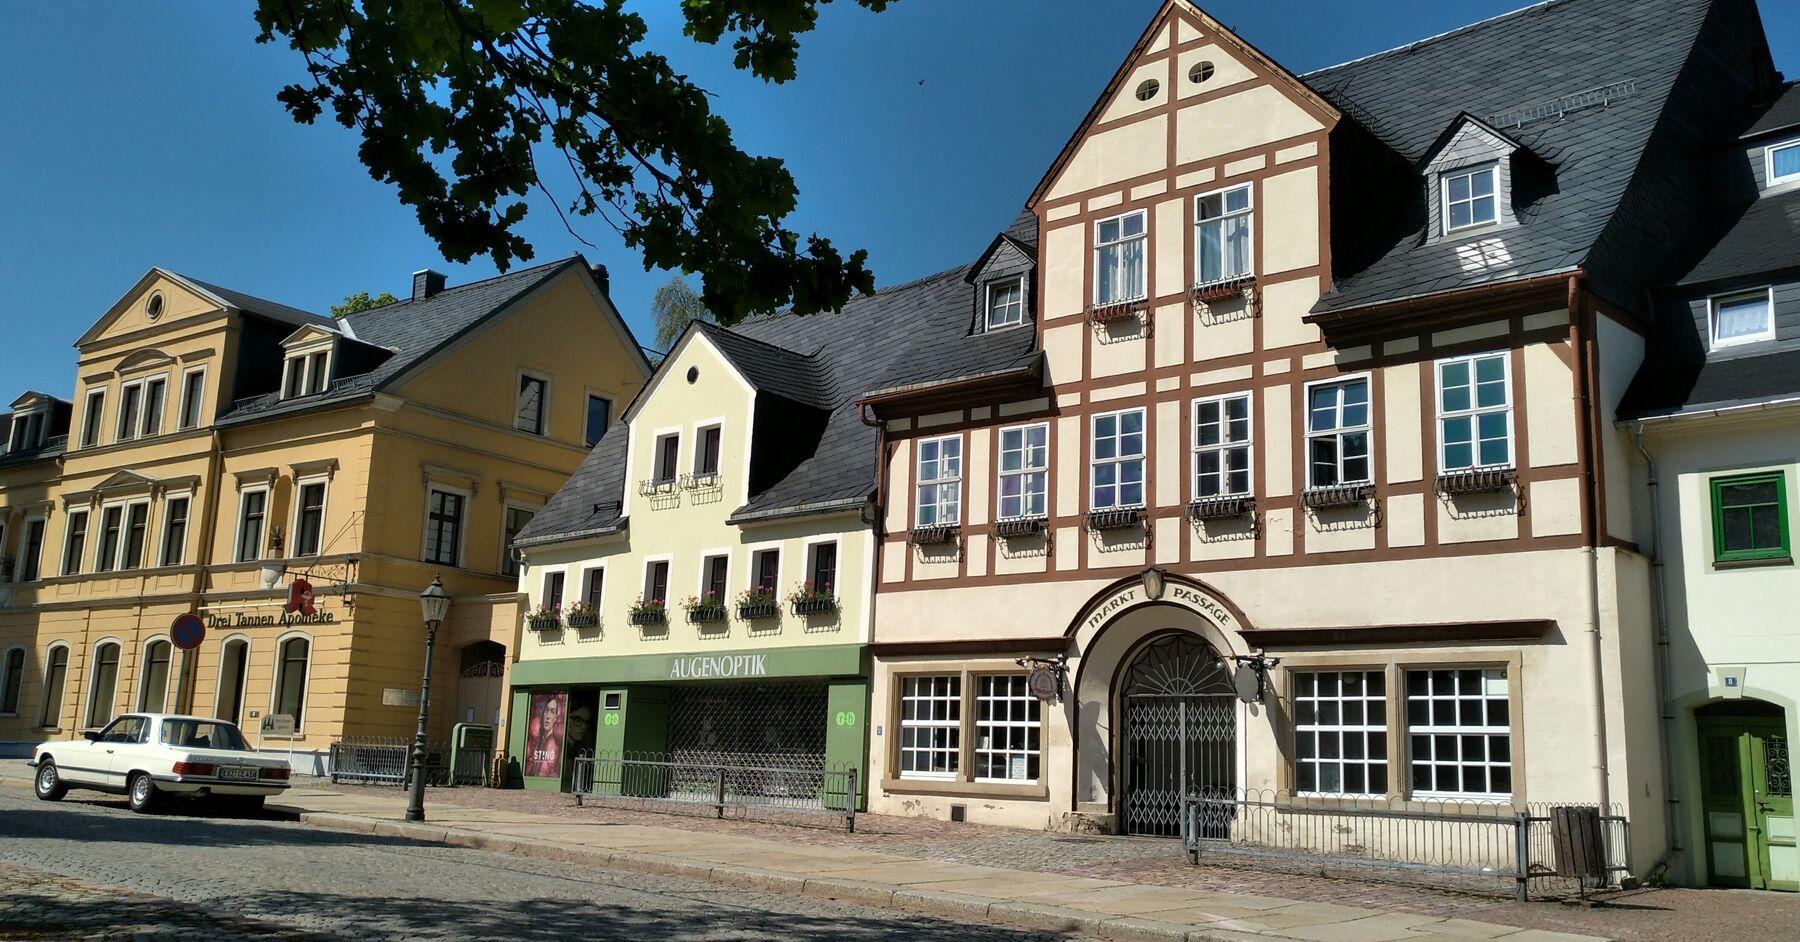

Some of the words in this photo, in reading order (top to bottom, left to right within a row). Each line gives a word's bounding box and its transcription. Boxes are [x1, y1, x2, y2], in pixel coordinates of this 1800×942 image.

[208, 613, 231, 628] Drei
[235, 612, 275, 627] Tannen
[1088, 590, 1135, 629] MARKT
[1173, 587, 1231, 626] PASSAGE
[670, 654, 767, 678] AUGENOPTIK
